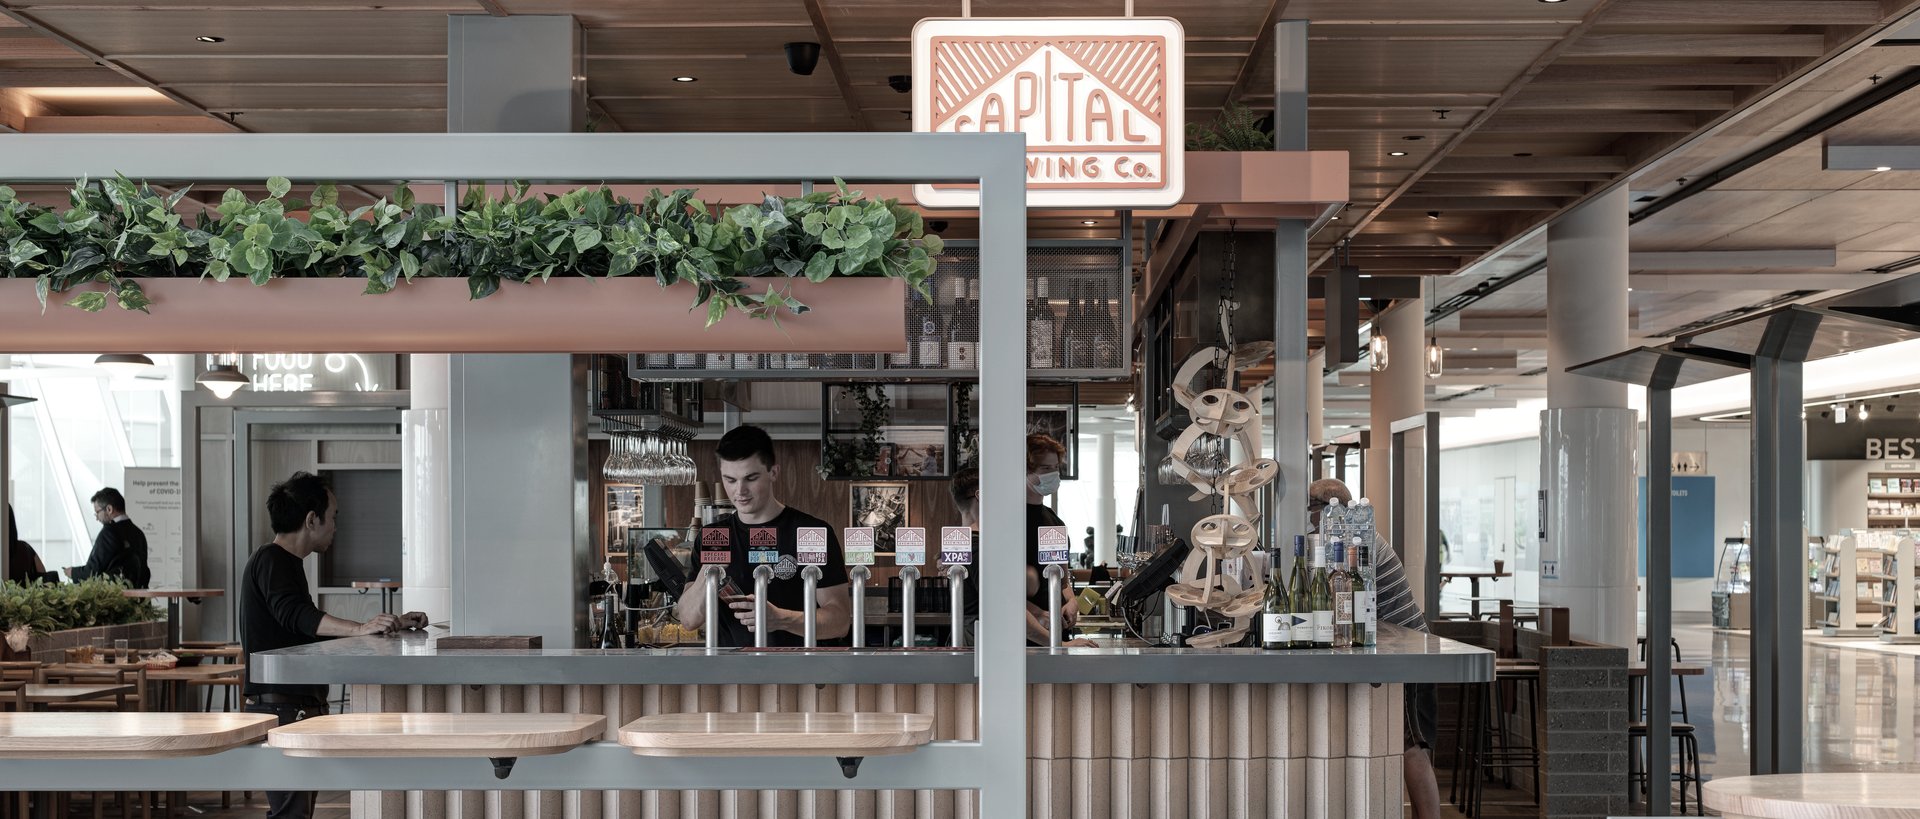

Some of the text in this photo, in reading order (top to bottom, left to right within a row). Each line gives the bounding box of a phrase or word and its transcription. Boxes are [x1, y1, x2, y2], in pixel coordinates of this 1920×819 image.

[955, 51, 1146, 142] CAPITAL
[1026, 157, 1100, 178] WING
[252, 373, 314, 392] HERE
[1866, 438, 1920, 460] BES
[944, 552, 963, 562] XPA
